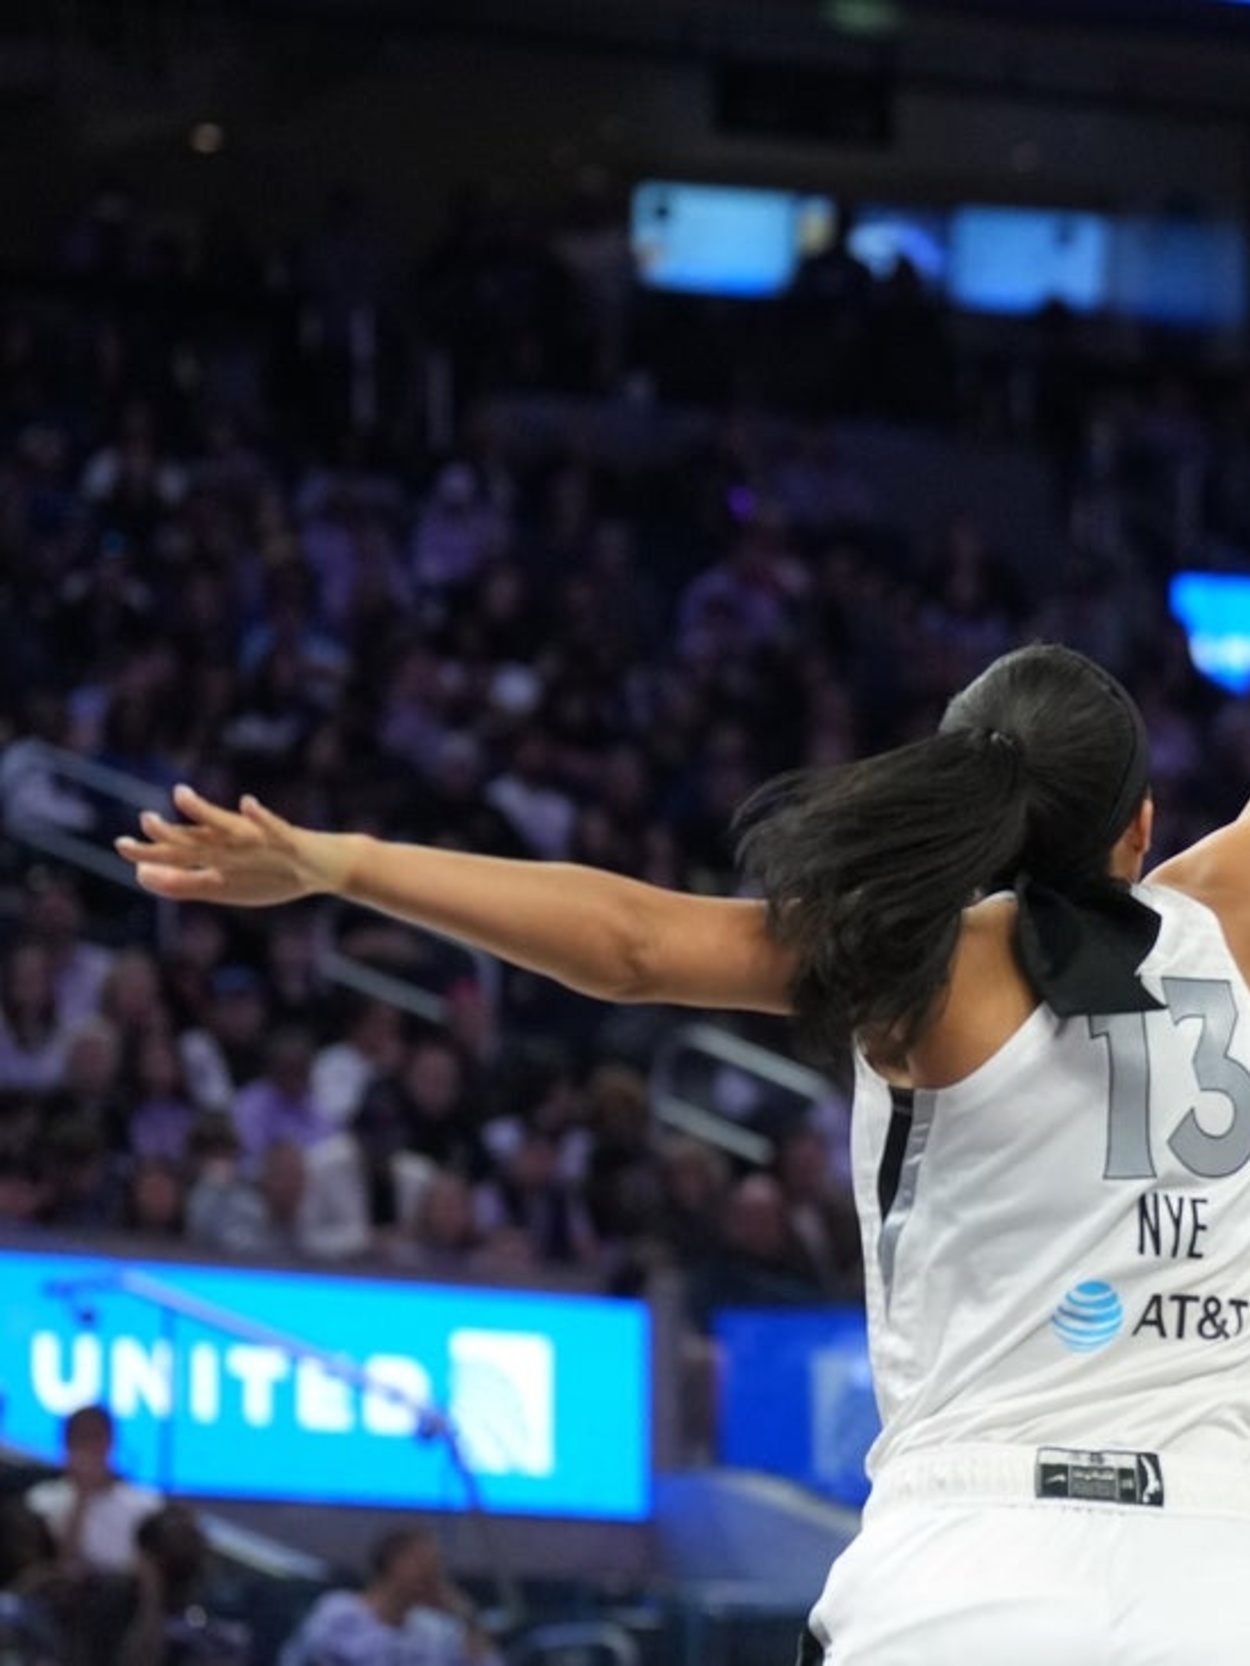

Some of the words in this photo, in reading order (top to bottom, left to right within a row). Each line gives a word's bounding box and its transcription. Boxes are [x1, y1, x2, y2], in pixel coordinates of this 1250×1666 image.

[1137, 1194, 1208, 1259] NYE
[1132, 1294, 1249, 1341] AT&T
[30, 1331, 433, 1437] UNITED
